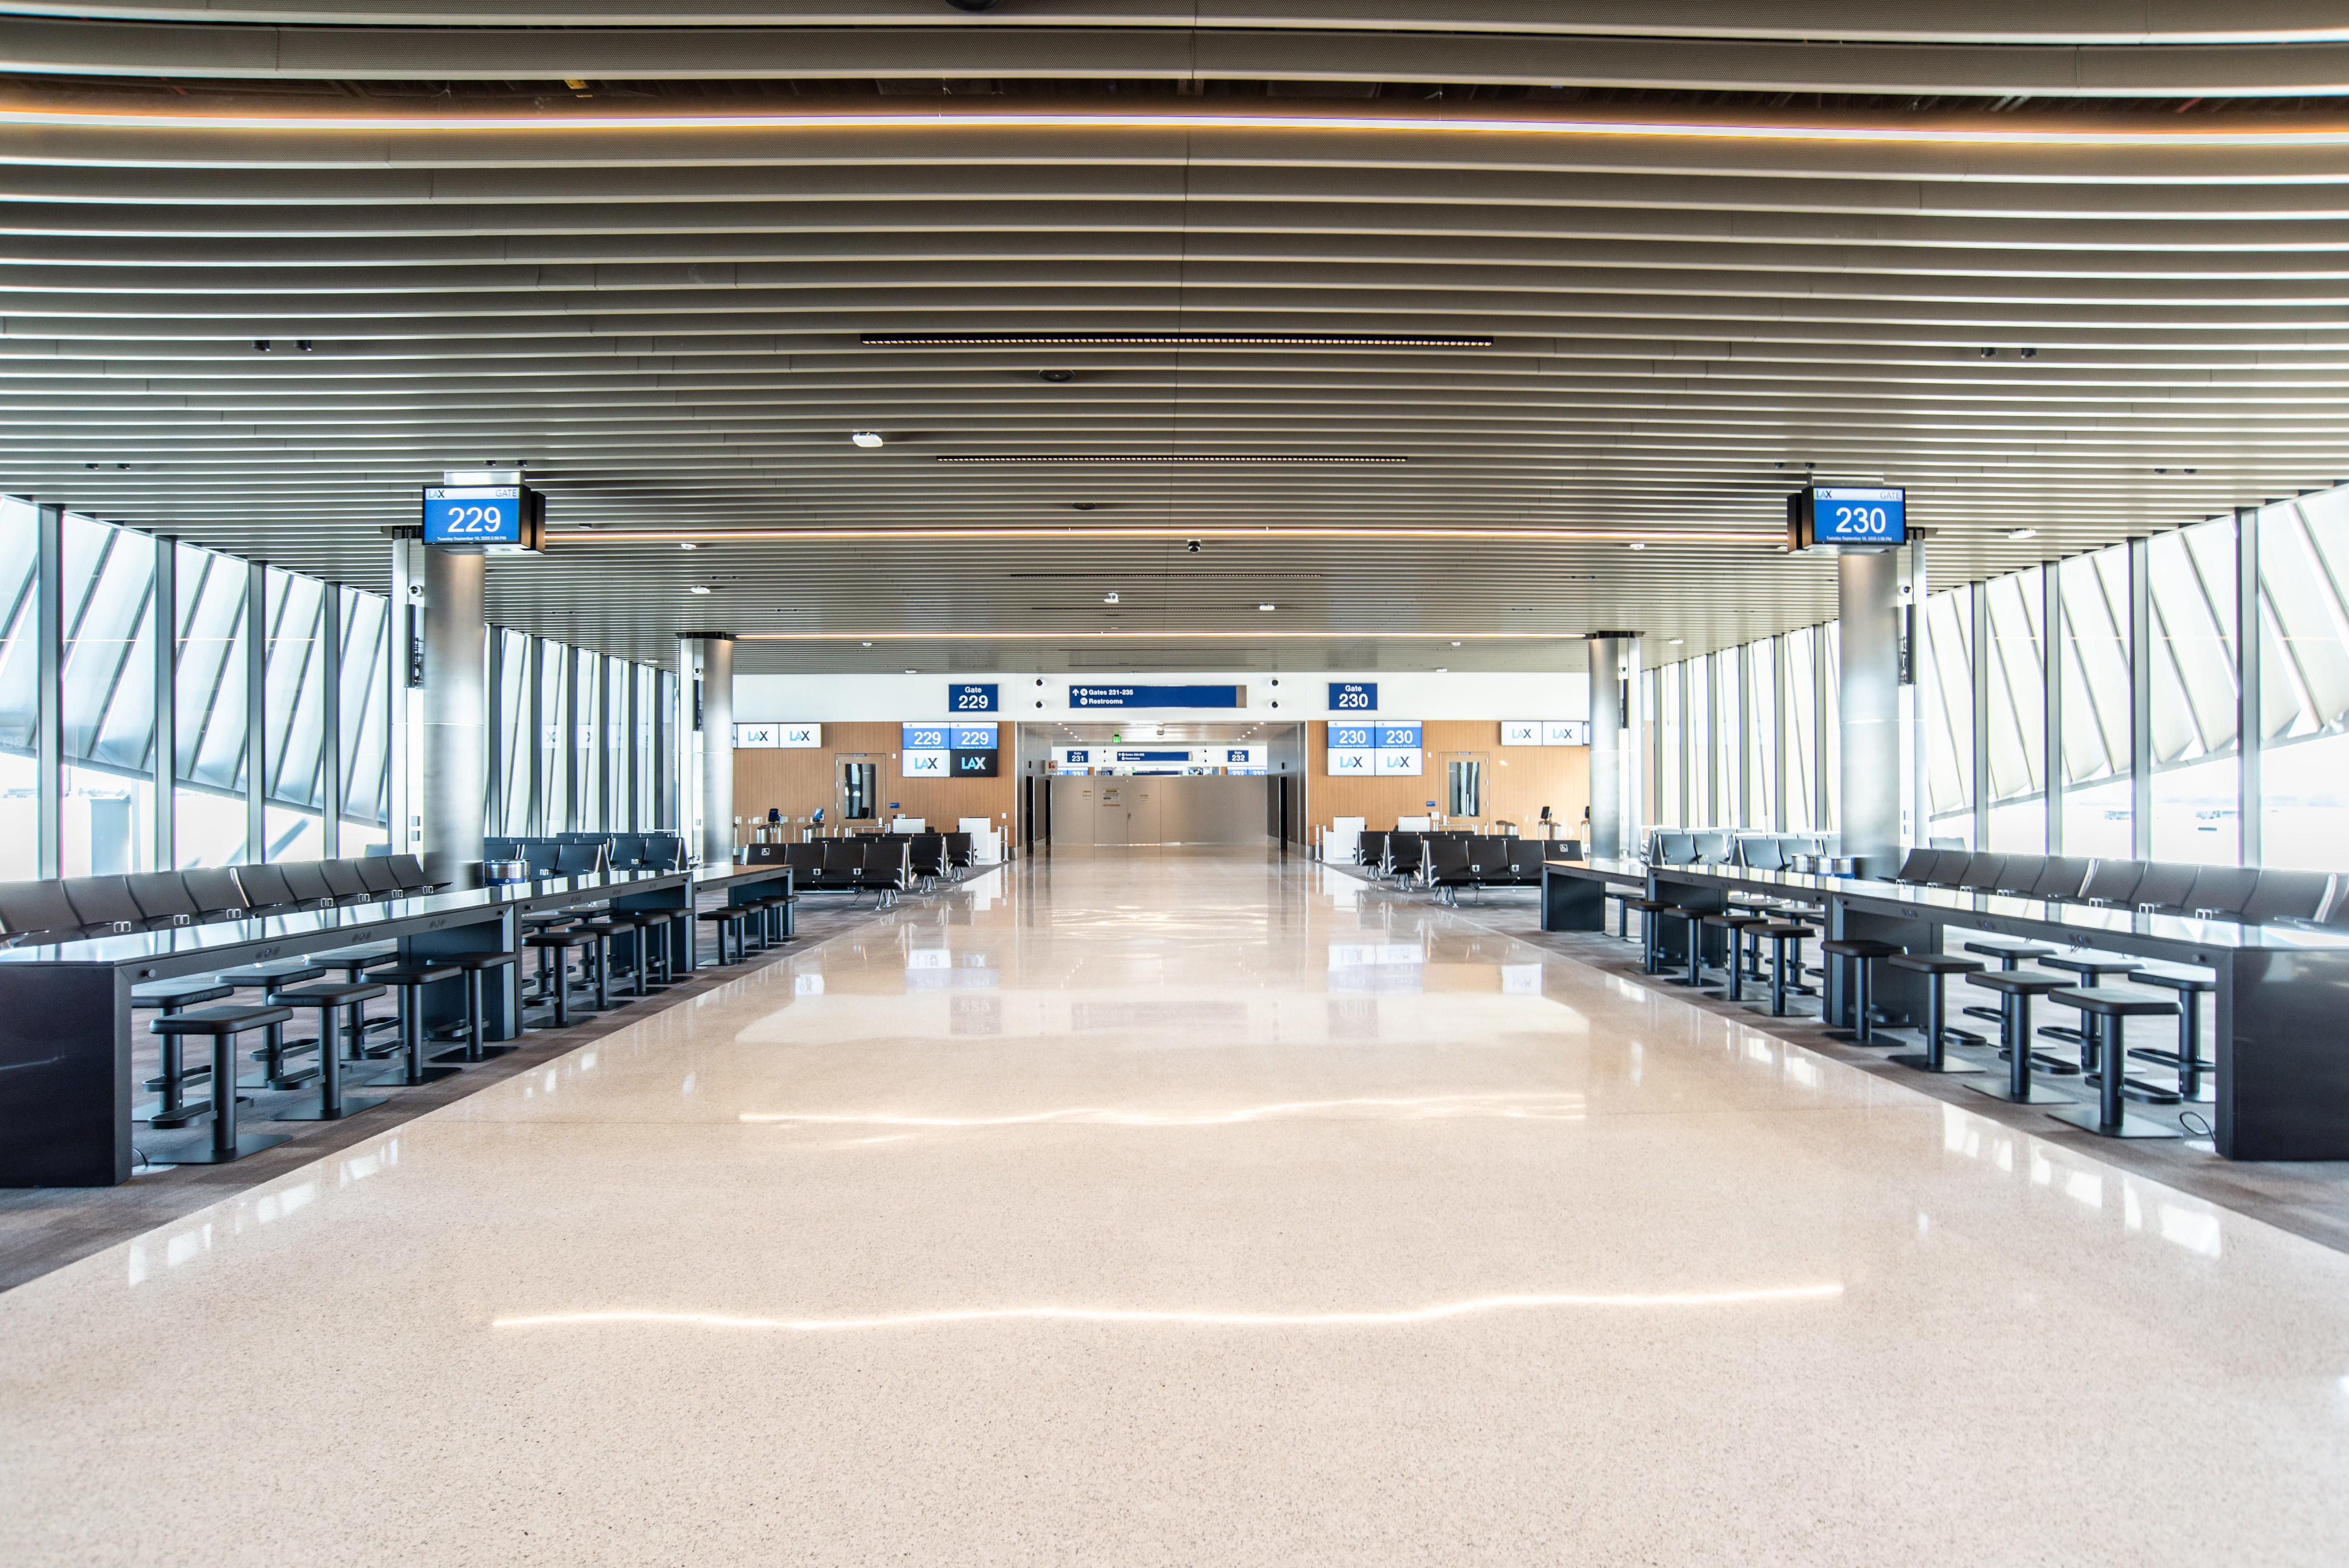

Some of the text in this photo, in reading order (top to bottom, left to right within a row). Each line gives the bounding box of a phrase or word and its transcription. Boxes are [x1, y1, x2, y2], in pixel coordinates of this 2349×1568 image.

[429, 490, 445, 498] LAX
[496, 489, 517, 497] GATE
[1816, 490, 1832, 498] LAX
[1880, 491, 1900, 500] GATE
[448, 506, 501, 533] 229
[1836, 507, 1886, 534] 230
[964, 686, 982, 694] Gate
[958, 695, 988, 710] 229
[1339, 693, 1368, 707] 230
[748, 731, 768, 741] LAX
[790, 731, 810, 741] LAX
[914, 731, 941, 745] 229
[961, 731, 989, 745] 229
[1339, 730, 1366, 744] 230
[1386, 730, 1413, 744] 230
[1512, 729, 1532, 739] LAX
[1553, 729, 1572, 739] LAX
[915, 757, 938, 769] LAX
[961, 757, 986, 769] LAX
[1340, 756, 1363, 768] LAX
[1387, 756, 1410, 768] LAX
